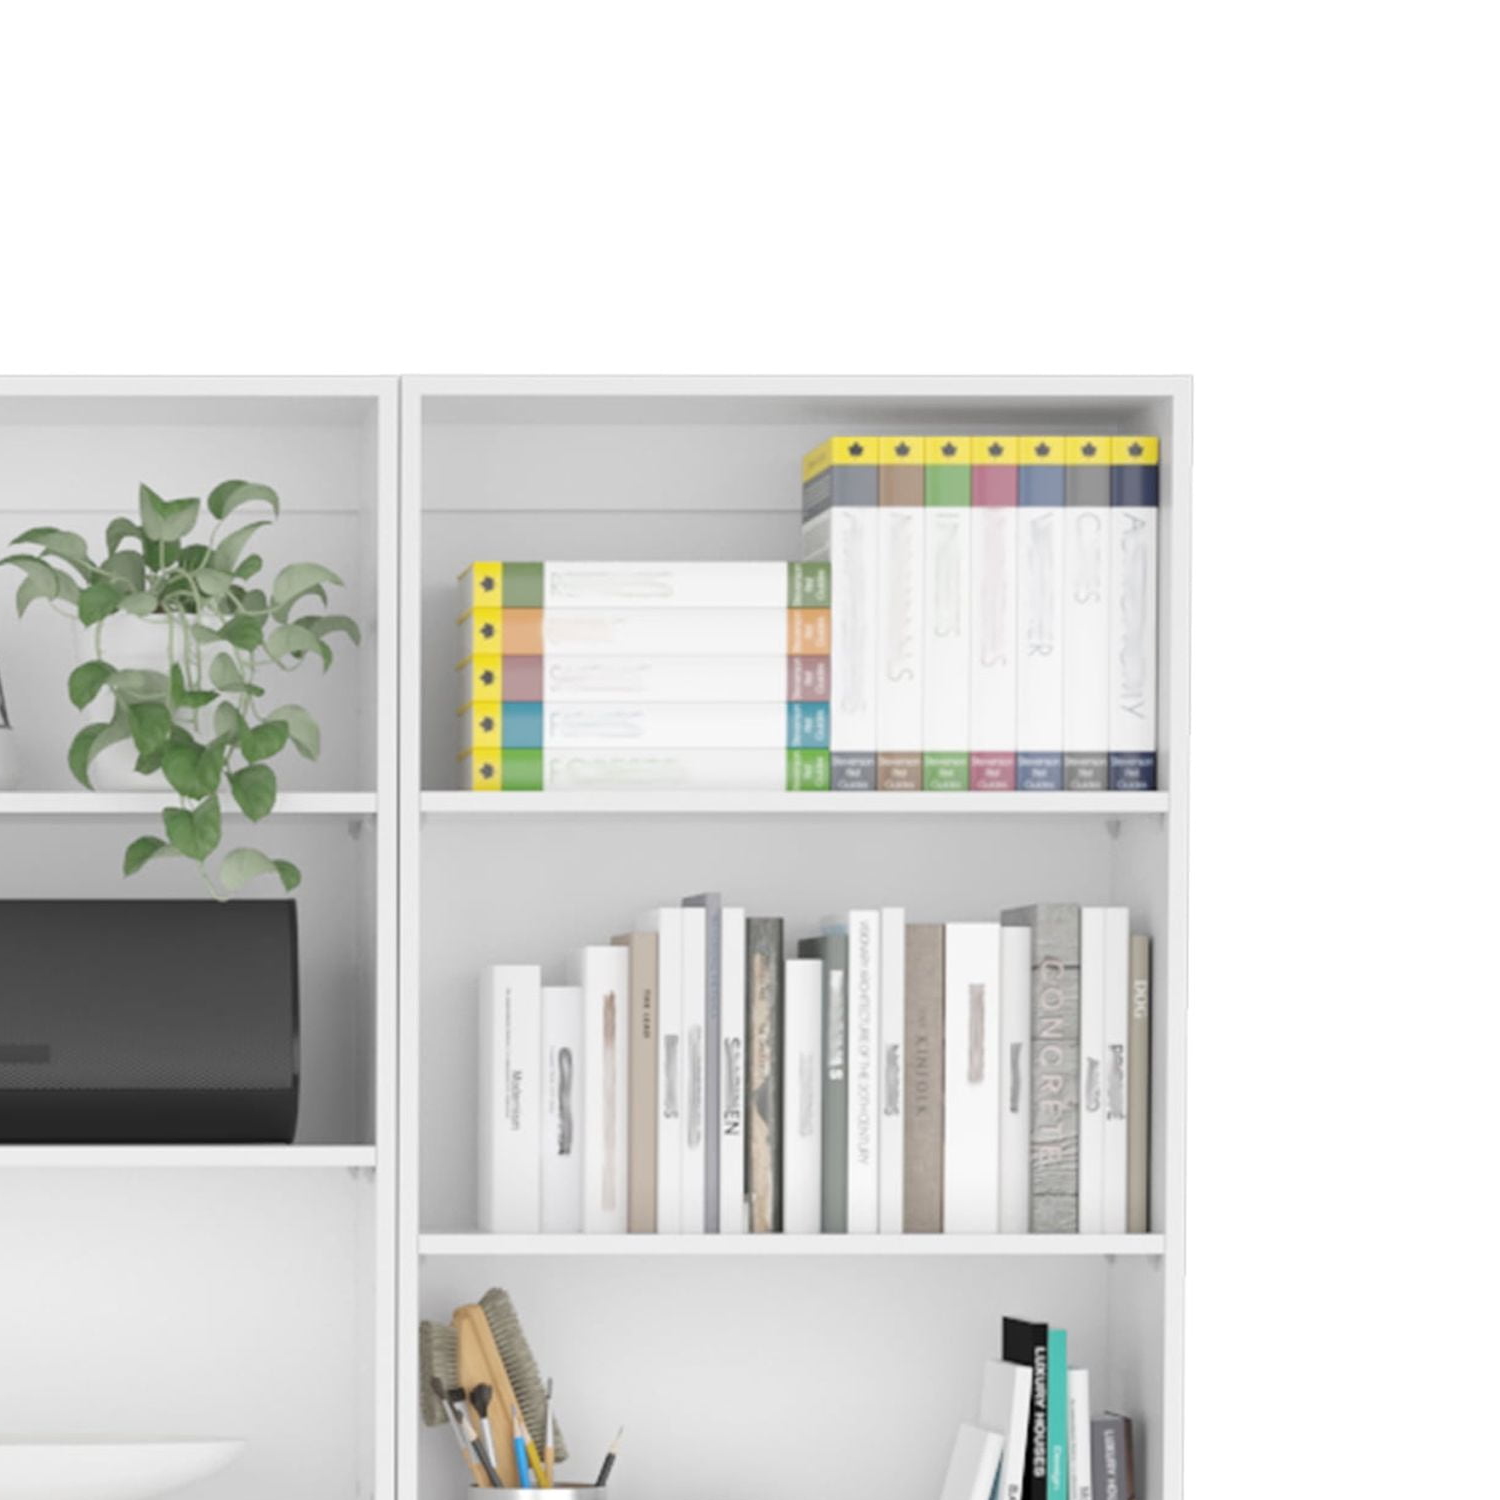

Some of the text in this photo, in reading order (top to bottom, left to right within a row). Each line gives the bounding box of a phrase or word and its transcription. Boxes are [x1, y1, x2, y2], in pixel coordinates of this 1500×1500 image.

[1133, 979, 1148, 1019] DOG
[915, 1034, 928, 1117] KINFOLK
[1038, 956, 1065, 1164] CONCRETE
[1032, 1346, 1046, 1478] LUXURY HOUSES
